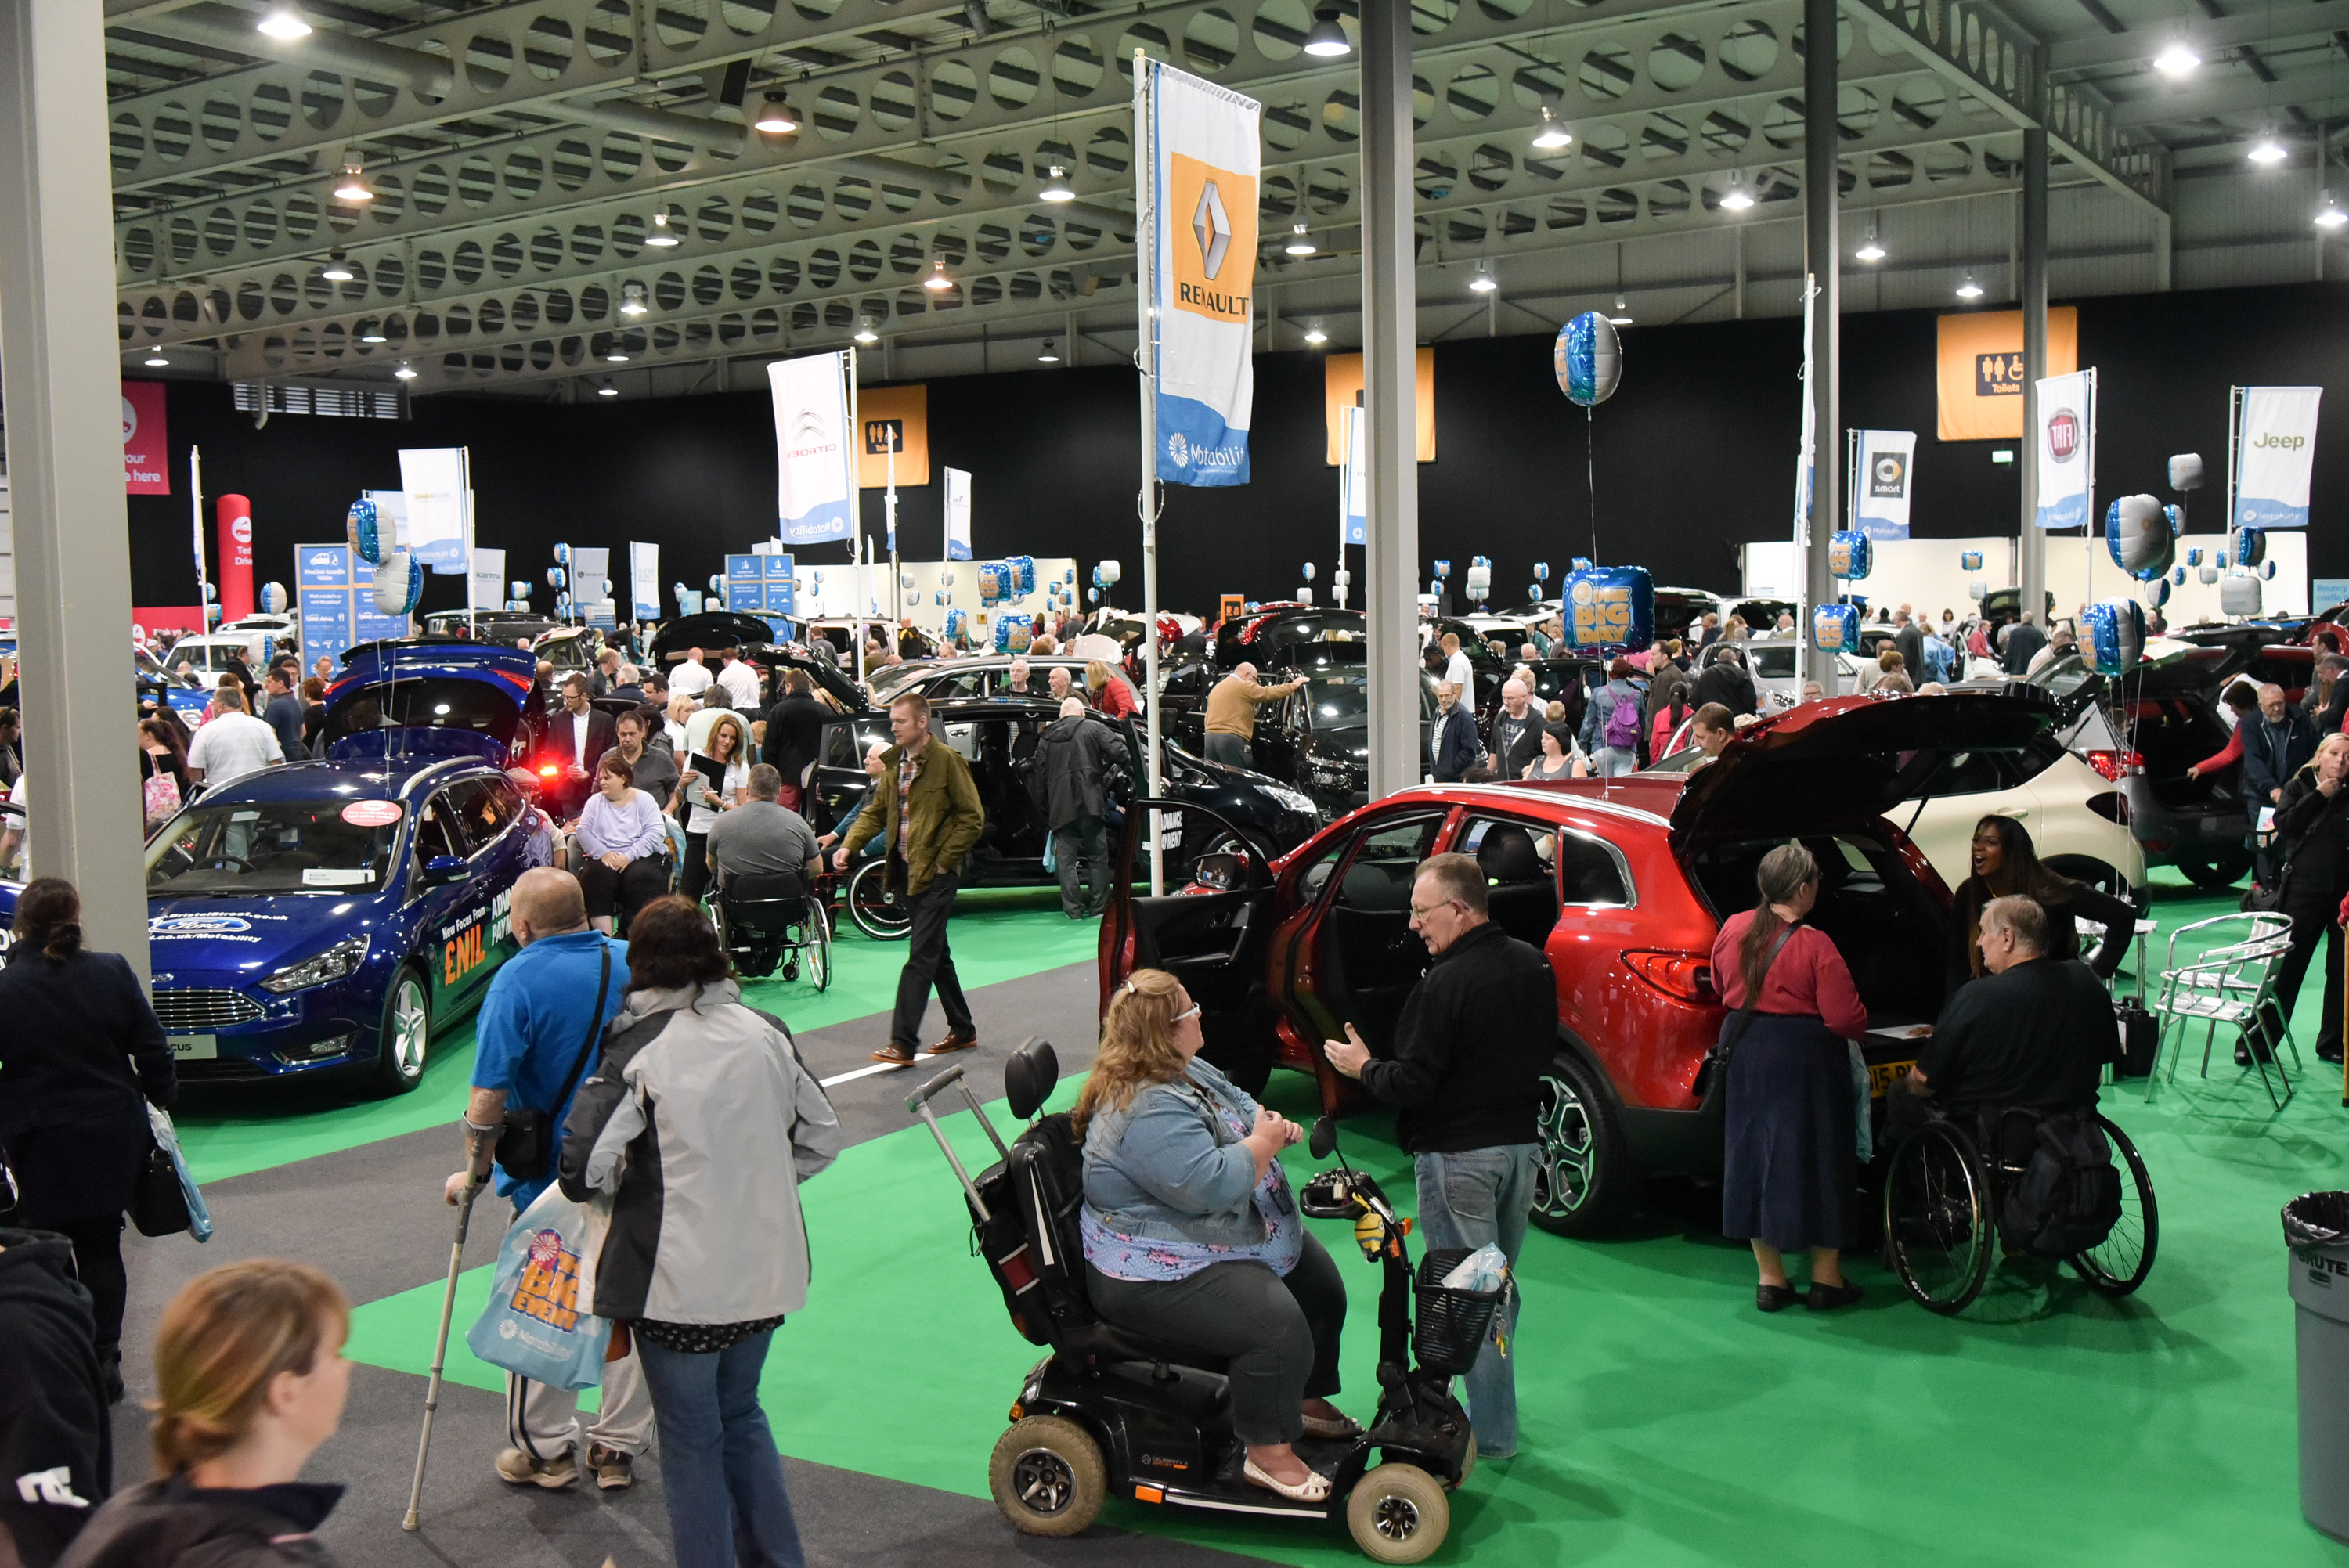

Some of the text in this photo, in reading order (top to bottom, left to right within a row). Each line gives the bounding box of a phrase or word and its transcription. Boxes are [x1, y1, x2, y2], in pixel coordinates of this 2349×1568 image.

[1180, 282, 1249, 315] RENAULT
[1992, 383, 2021, 393] Toilets
[2253, 432, 2305, 452] Jeep
[124, 454, 146, 464] our
[1190, 443, 1246, 466] Motabilit
[133, 470, 161, 482] here
[1875, 484, 1900, 494] smart
[235, 557, 253, 566] Driv
[1592, 588, 1629, 604] ONE
[1575, 603, 1629, 625] BIG
[1577, 625, 1629, 644] DAY
[1161, 830, 1182, 851] AYMENT
[167, 920, 230, 929] Ford
[442, 906, 485, 940] New Focus From
[492, 914, 513, 946] PAYM
[445, 924, 485, 986] £NIL
[2298, 1252, 2347, 1278] BRUTE
[511, 1290, 579, 1332] EVENT
